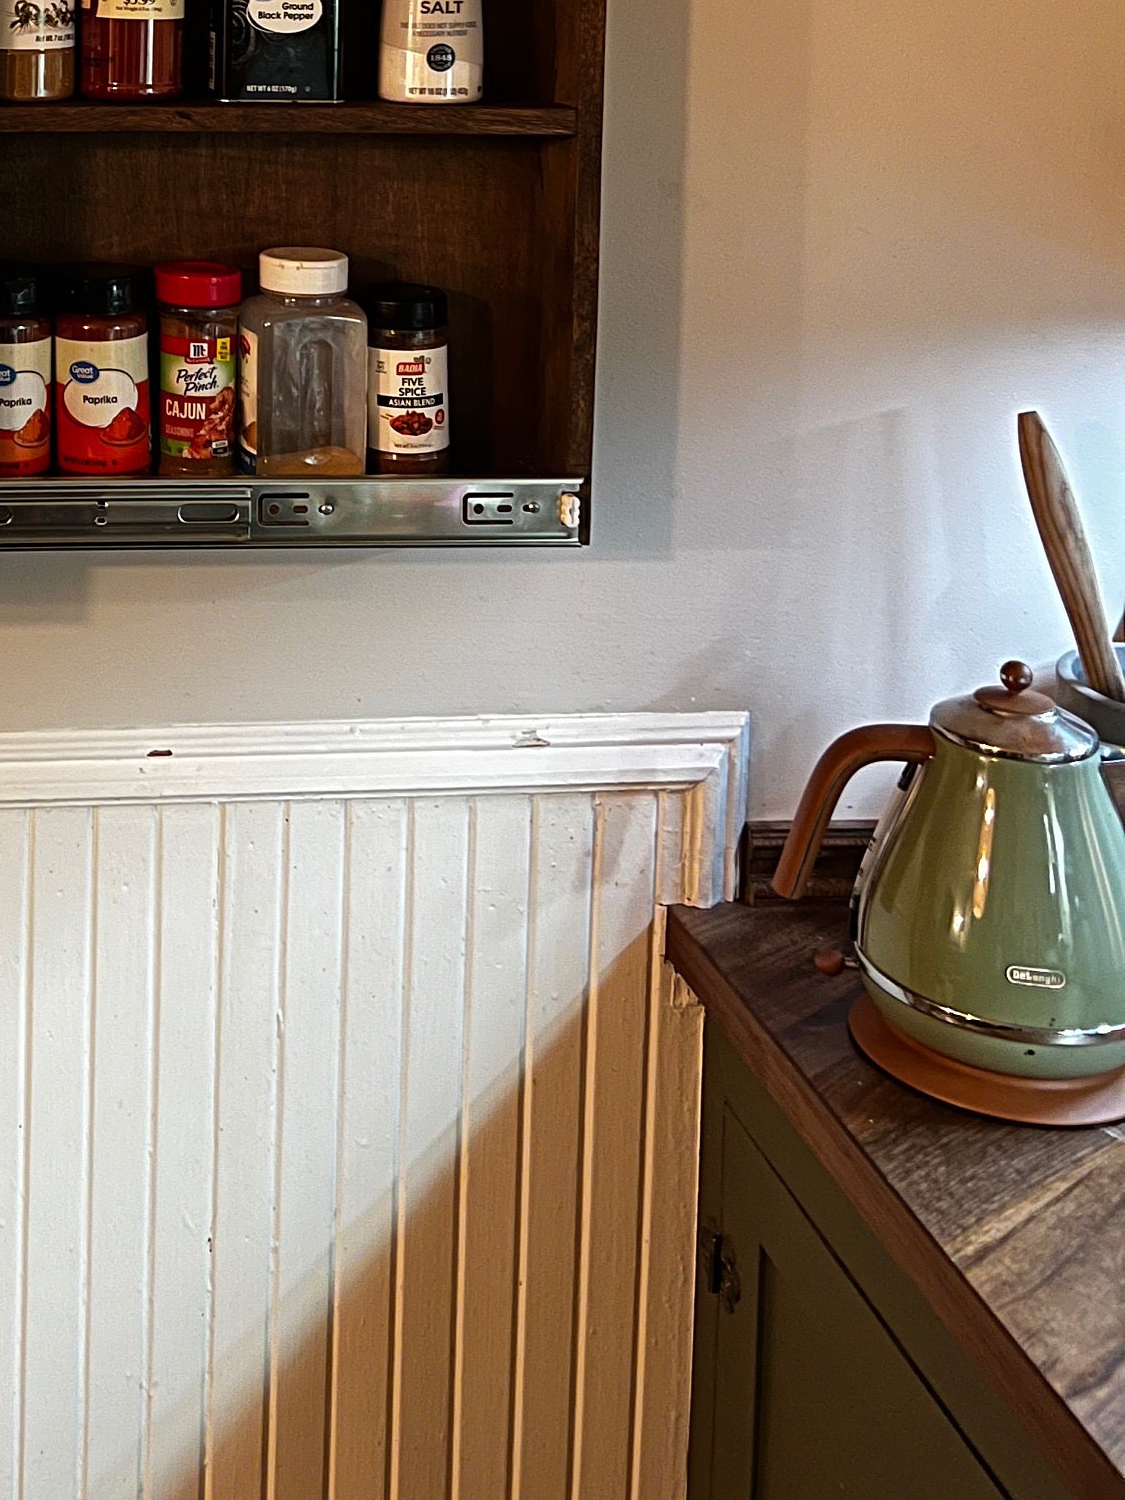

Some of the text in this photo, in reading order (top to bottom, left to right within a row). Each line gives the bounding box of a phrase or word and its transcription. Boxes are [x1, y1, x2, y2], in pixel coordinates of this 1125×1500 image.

[281, 2, 314, 11] Ground
[420, 0, 464, 14] SALT
[258, 11, 314, 22] Black Pepper
[429, 54, 453, 62] 1848
[70, 365, 93, 375] Great
[398, 363, 423, 373] BADIA
[176, 366, 218, 383] Perfect
[184, 374, 217, 396] Pinch
[401, 377, 424, 387] FIVE
[398, 387, 427, 397] SPICE
[83, 395, 118, 405] Paprika
[388, 398, 435, 407] ASIAN BLEND
[165, 399, 206, 420] CAJUN
